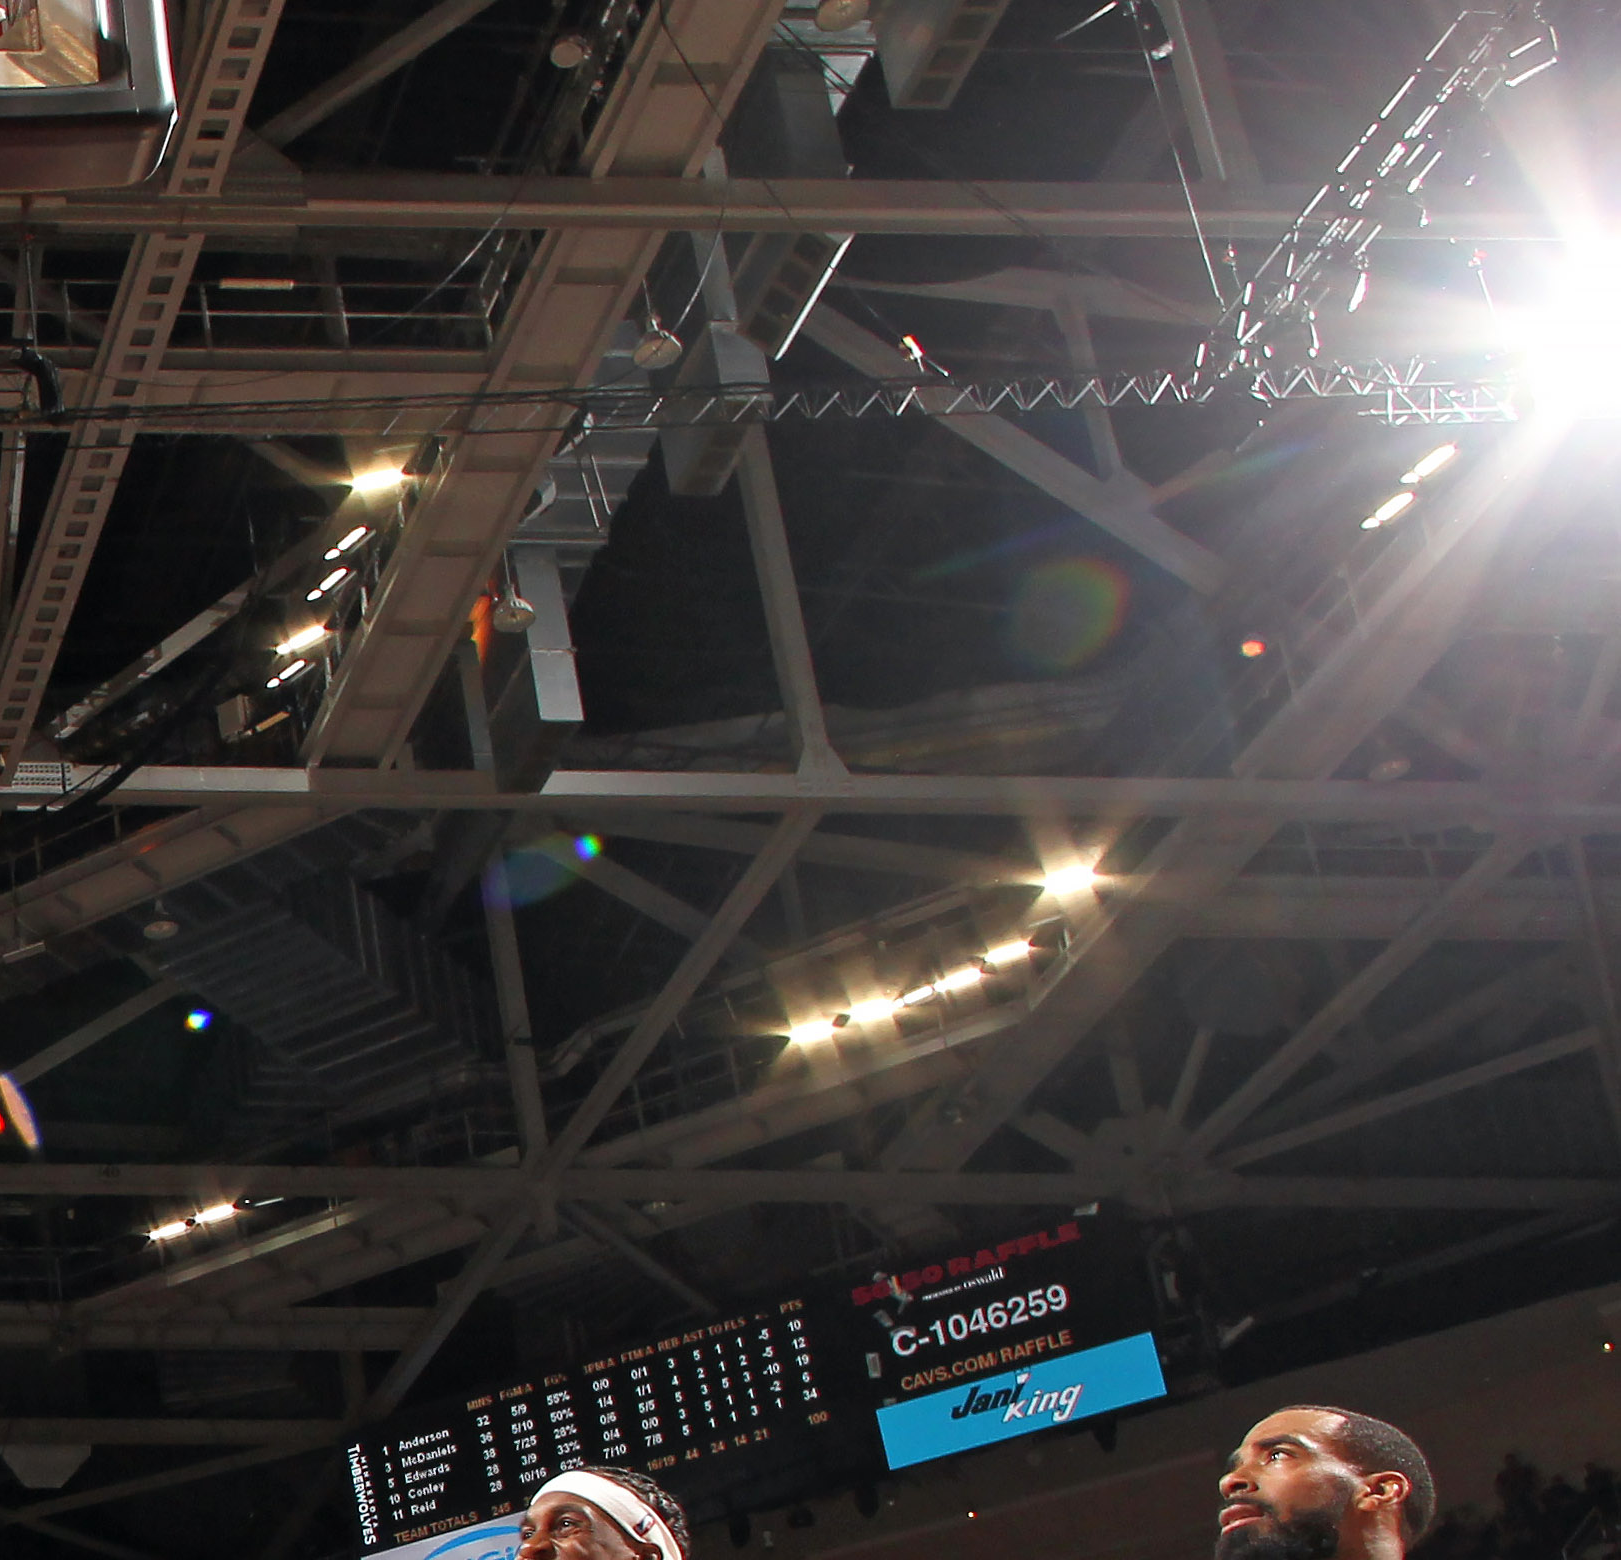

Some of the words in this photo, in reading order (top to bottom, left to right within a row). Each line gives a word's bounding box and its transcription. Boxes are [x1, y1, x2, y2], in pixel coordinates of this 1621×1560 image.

[891, 1284, 1069, 1357] C-1046259
[397, 1428, 451, 1453] Anderson
[400, 1443, 458, 1469] McDaniels
[403, 1462, 451, 1485] Edwards
[347, 1443, 376, 1545] TIMBERWOLVES
[406, 1480, 446, 1500] Conley
[409, 1498, 438, 1517] Reid
